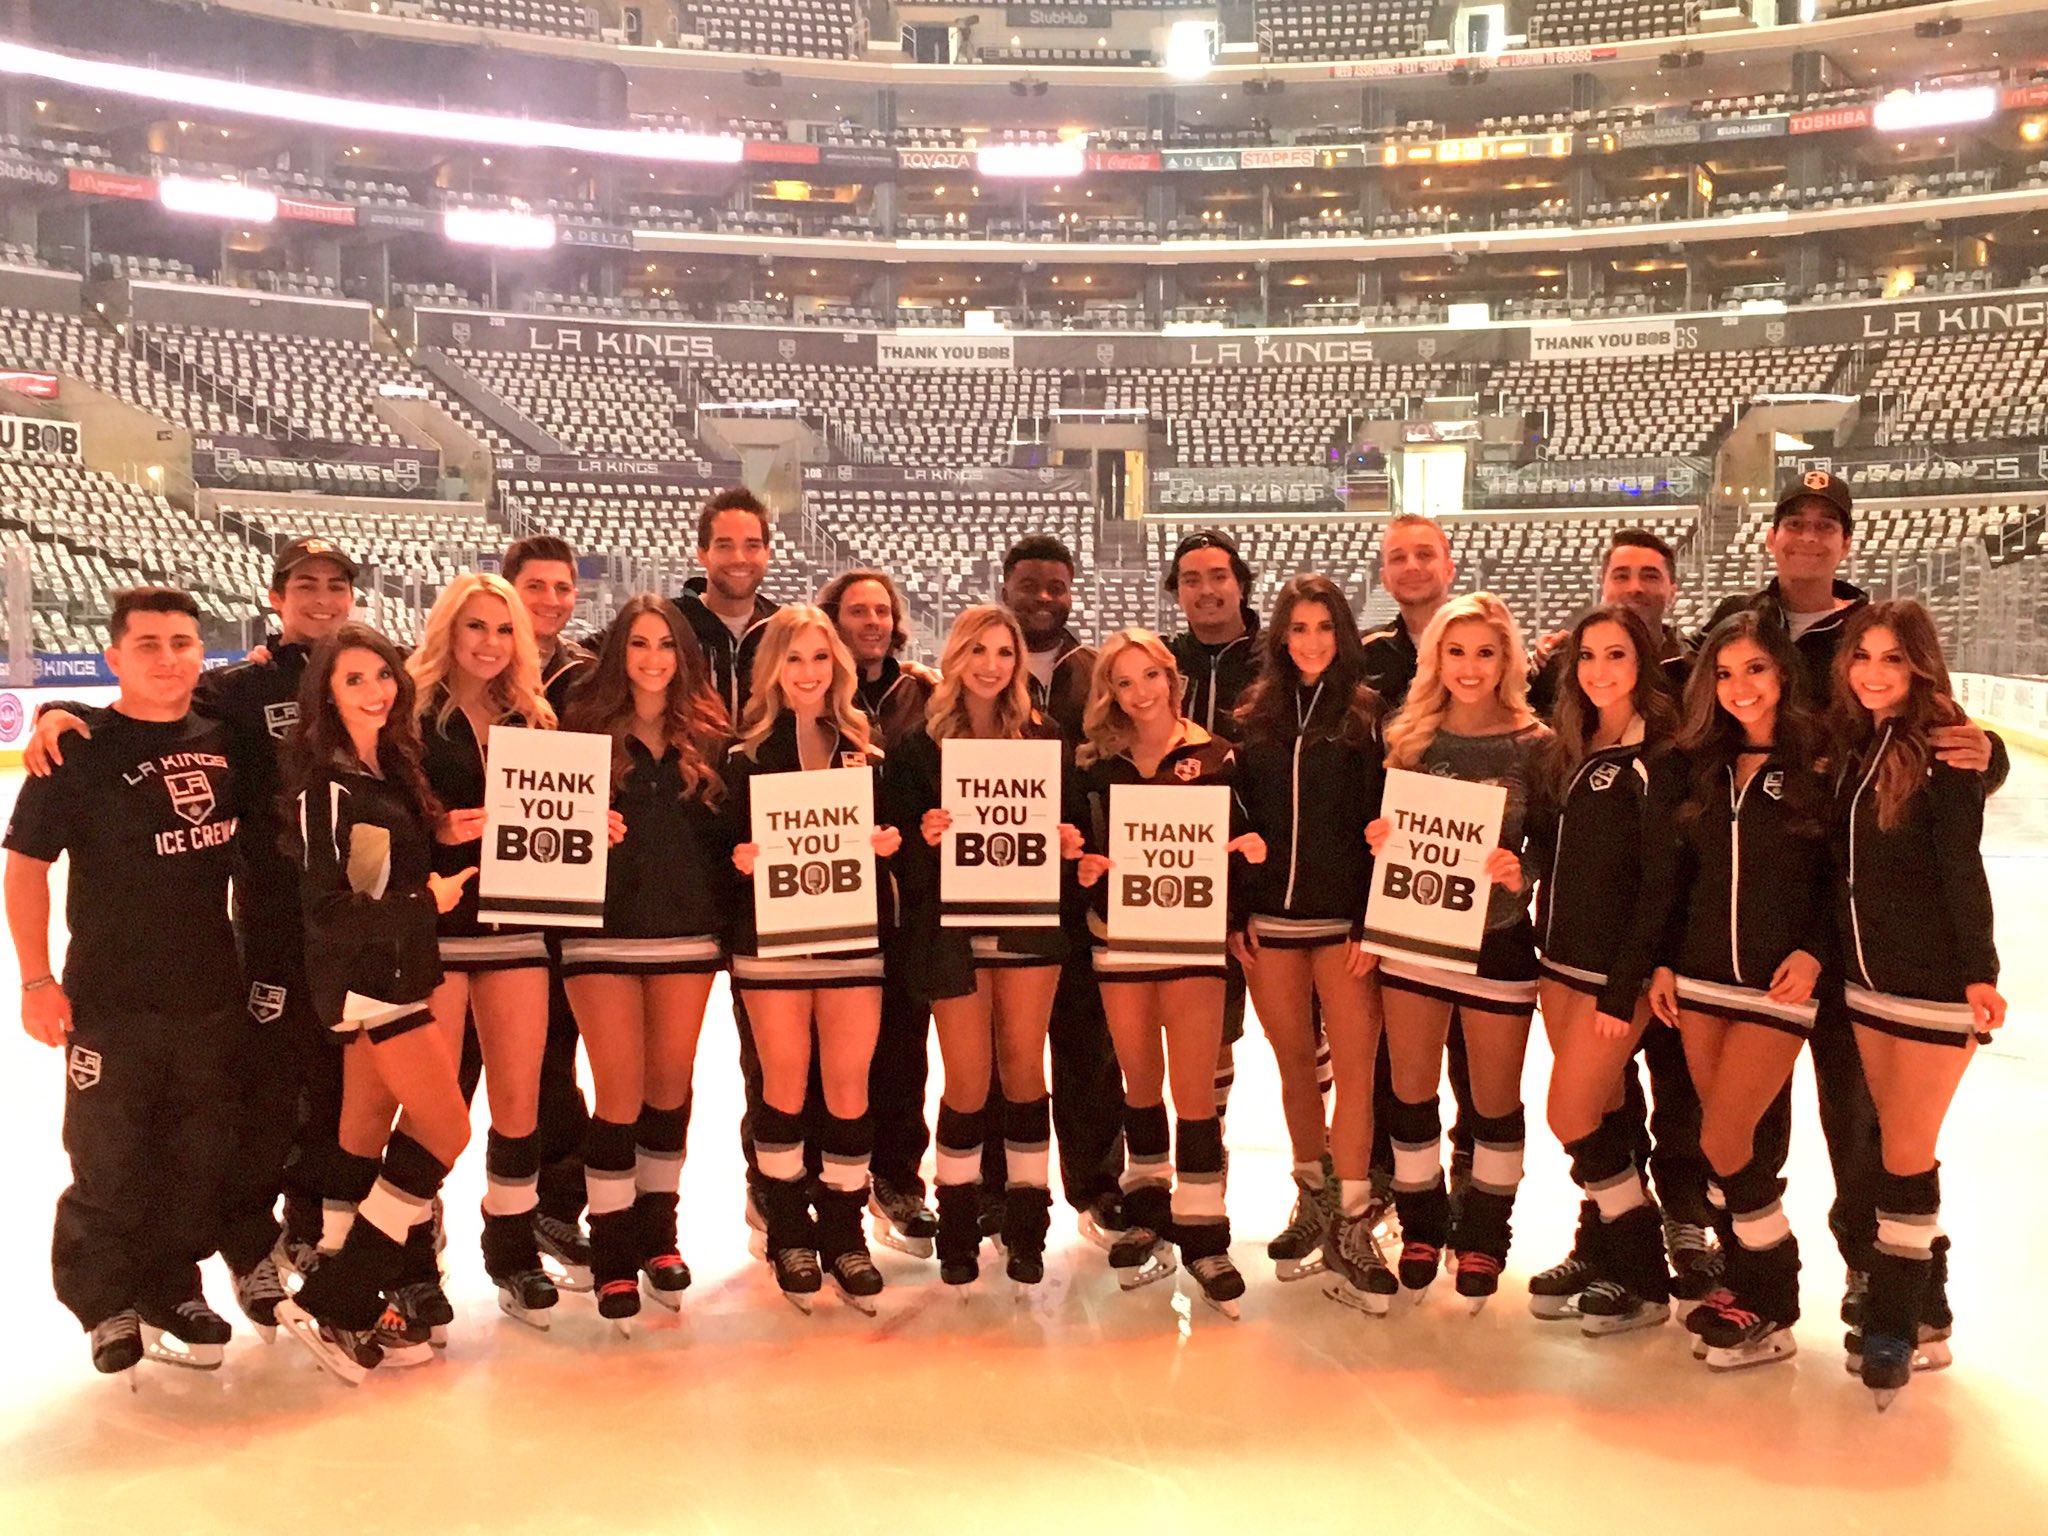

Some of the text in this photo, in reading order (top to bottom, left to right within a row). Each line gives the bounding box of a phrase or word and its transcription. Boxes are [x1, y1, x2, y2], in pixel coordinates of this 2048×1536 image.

[1030, 9, 1088, 24] StubHub
[1556, 50, 1592, 64] 69050
[1790, 109, 1867, 132] TOSHIBA
[900, 153, 970, 168] TOYOTA
[1184, 155, 1236, 168] DELTA
[578, 230, 630, 244] DELTA
[1863, 302, 2048, 337] LA KING
[530, 327, 714, 357] LA KINGS
[1534, 331, 1670, 350] THANK YOU BOB
[881, 346, 1010, 359] THANK YOU BOB
[1190, 341, 1373, 364] LA KINGS
[22, 422, 78, 454] BOB
[578, 461, 659, 473] LA KINGS
[904, 469, 983, 480] LA KINGS
[44, 660, 96, 676] KINGS
[122, 753, 229, 786] LA KINGS
[502, 768, 595, 794] THANK
[170, 776, 207, 796] LA
[956, 778, 1047, 799] THANK
[520, 798, 574, 821] YOU
[766, 805, 859, 831] THANK
[975, 805, 1027, 825] YOU
[155, 817, 239, 856] ICE CREW
[1124, 822, 1214, 843] THANK
[1394, 809, 1485, 845] THANK
[496, 824, 594, 865] BOB
[787, 834, 840, 856] YOU
[955, 832, 1047, 867] BOB
[1408, 840, 1460, 867] YOU
[1142, 849, 1194, 869] YOU
[768, 858, 862, 898] BOB
[1383, 862, 1476, 912] BOB
[1122, 874, 1214, 908] BOB
